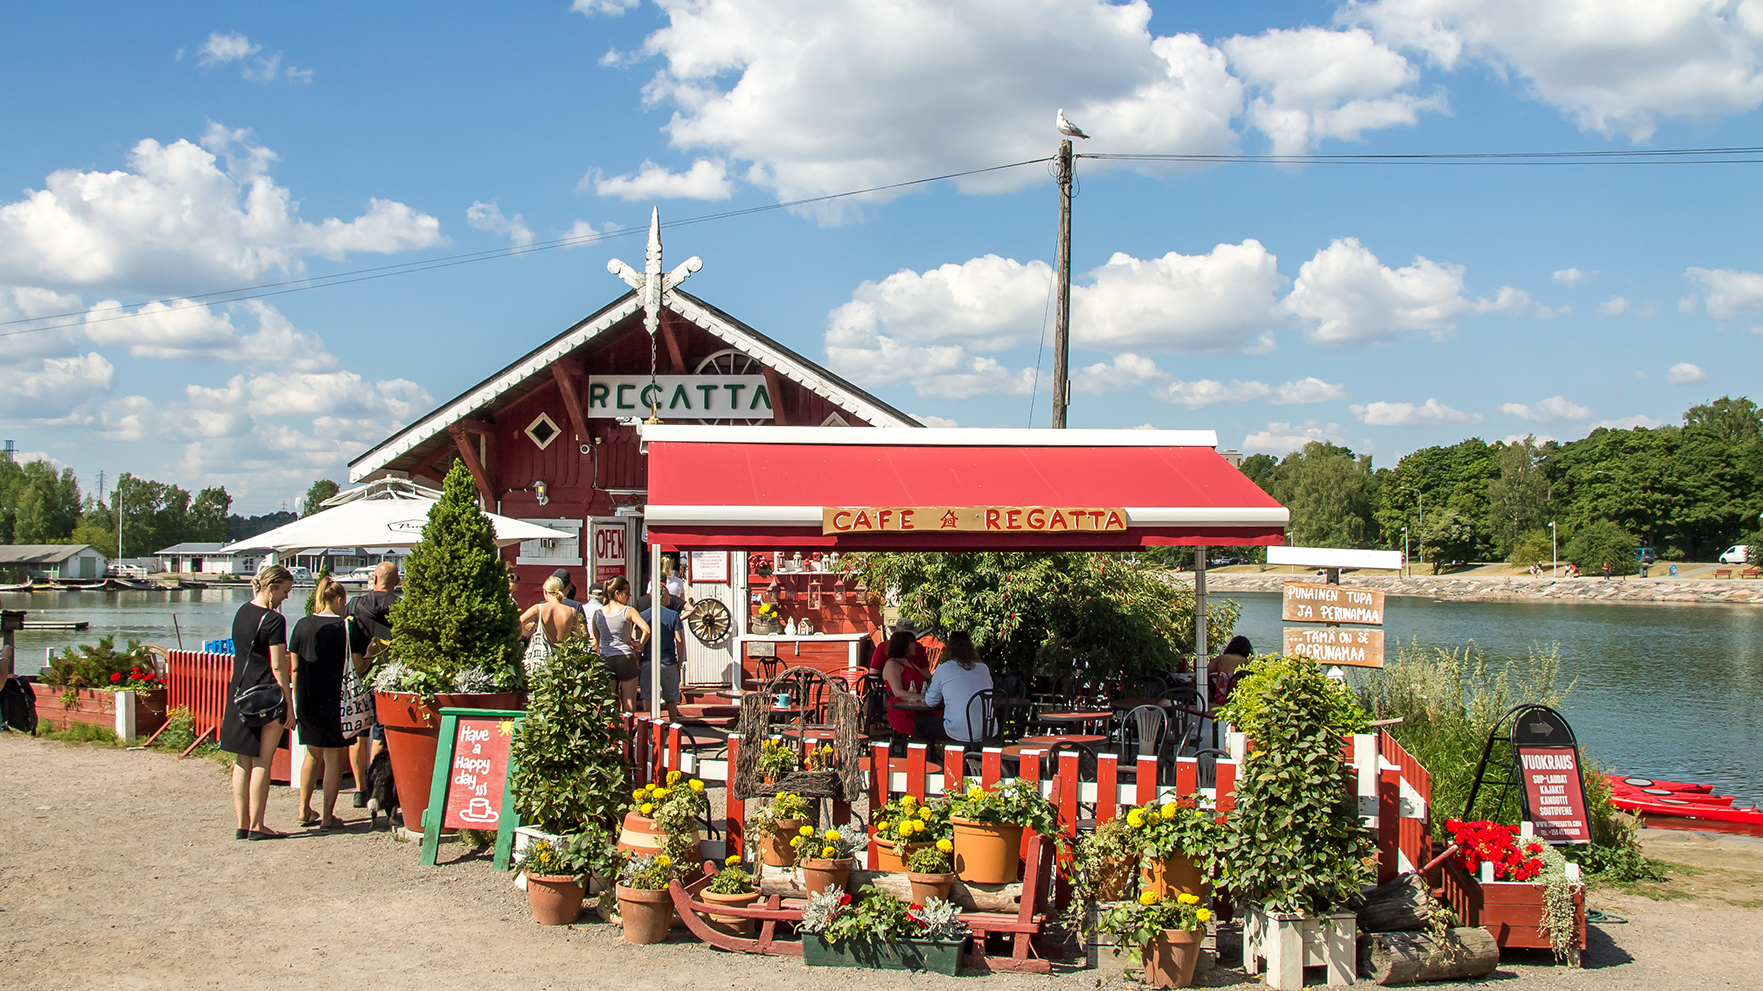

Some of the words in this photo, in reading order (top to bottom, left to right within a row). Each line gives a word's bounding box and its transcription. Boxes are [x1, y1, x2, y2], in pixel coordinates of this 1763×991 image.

[589, 384, 772, 409] REGATTA
[832, 509, 915, 531] CAFE
[984, 508, 1124, 531] REGATTA
[596, 529, 625, 559] OPEN
[1288, 585, 1338, 601] PUNAINEN
[1346, 592, 1372, 605] TUPA
[1297, 605, 1313, 618] JA
[1320, 605, 1379, 622] PERUNAMAA
[1339, 632, 1352, 644] ON
[1358, 632, 1369, 644] SE
[461, 724, 491, 744] Have
[471, 743, 482, 755] a
[455, 756, 491, 775] Happy
[1521, 754, 1574, 770] VUOKRAUS
[454, 769, 477, 790] day
[1533, 775, 1567, 784] SUP-LAUDAT
[1540, 786, 1564, 794] KAJAKIT
[1540, 796, 1568, 805] KANOOTIT
[1539, 807, 1573, 815] SOUTUVENE
